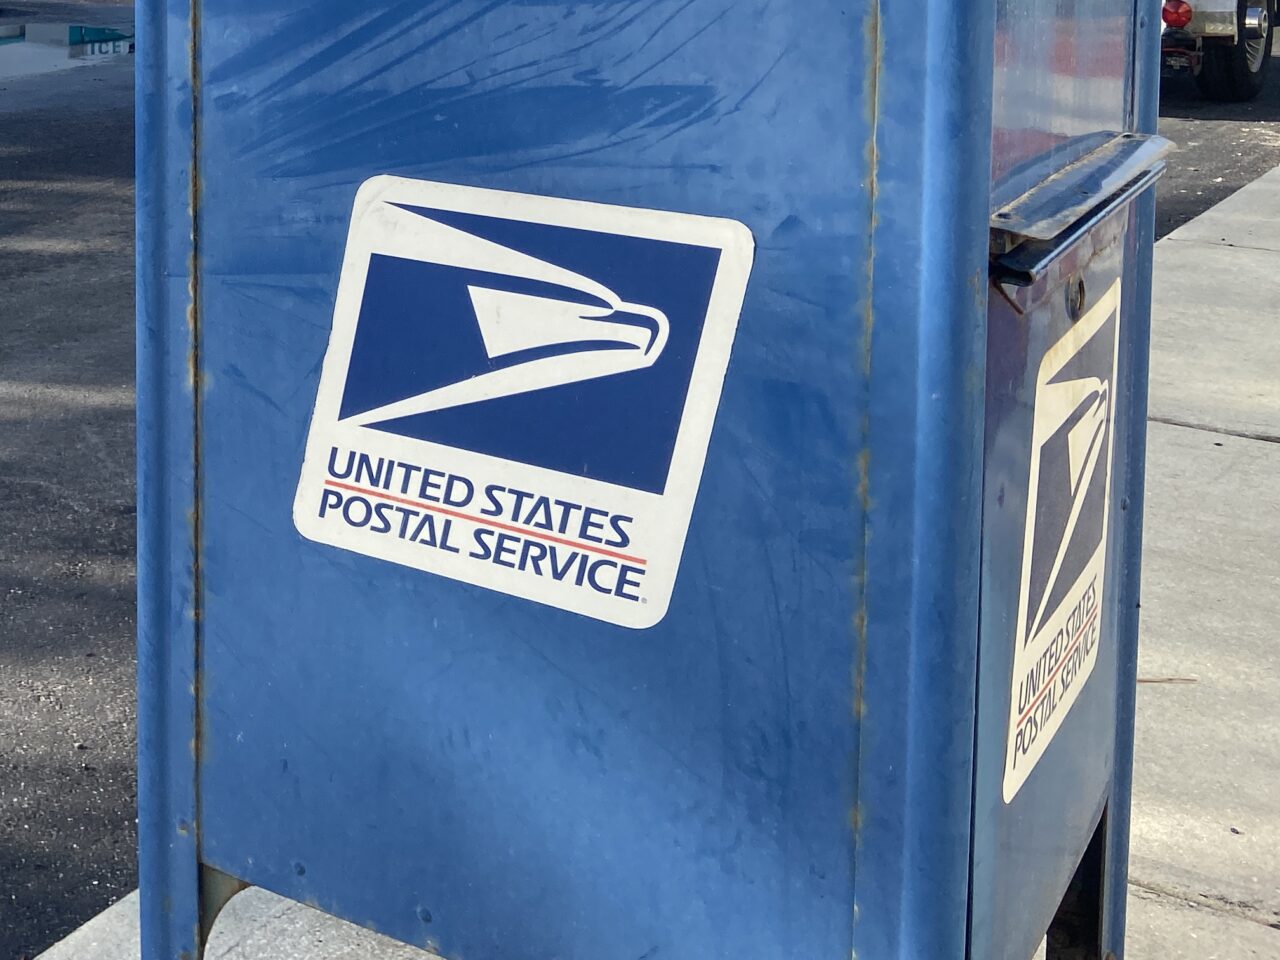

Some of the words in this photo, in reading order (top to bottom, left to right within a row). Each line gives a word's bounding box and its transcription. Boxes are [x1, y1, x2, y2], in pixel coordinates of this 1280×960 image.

[318, 488, 460, 553] POSTAL
[469, 527, 645, 602] SERVICE
[327, 446, 474, 508] UNITED
[480, 485, 633, 548] STATES
[1013, 680, 1057, 770] POSTAL
[1059, 612, 1097, 701] SERVICE
[1018, 628, 1063, 715] UNITED
[1063, 573, 1097, 652] STATES
